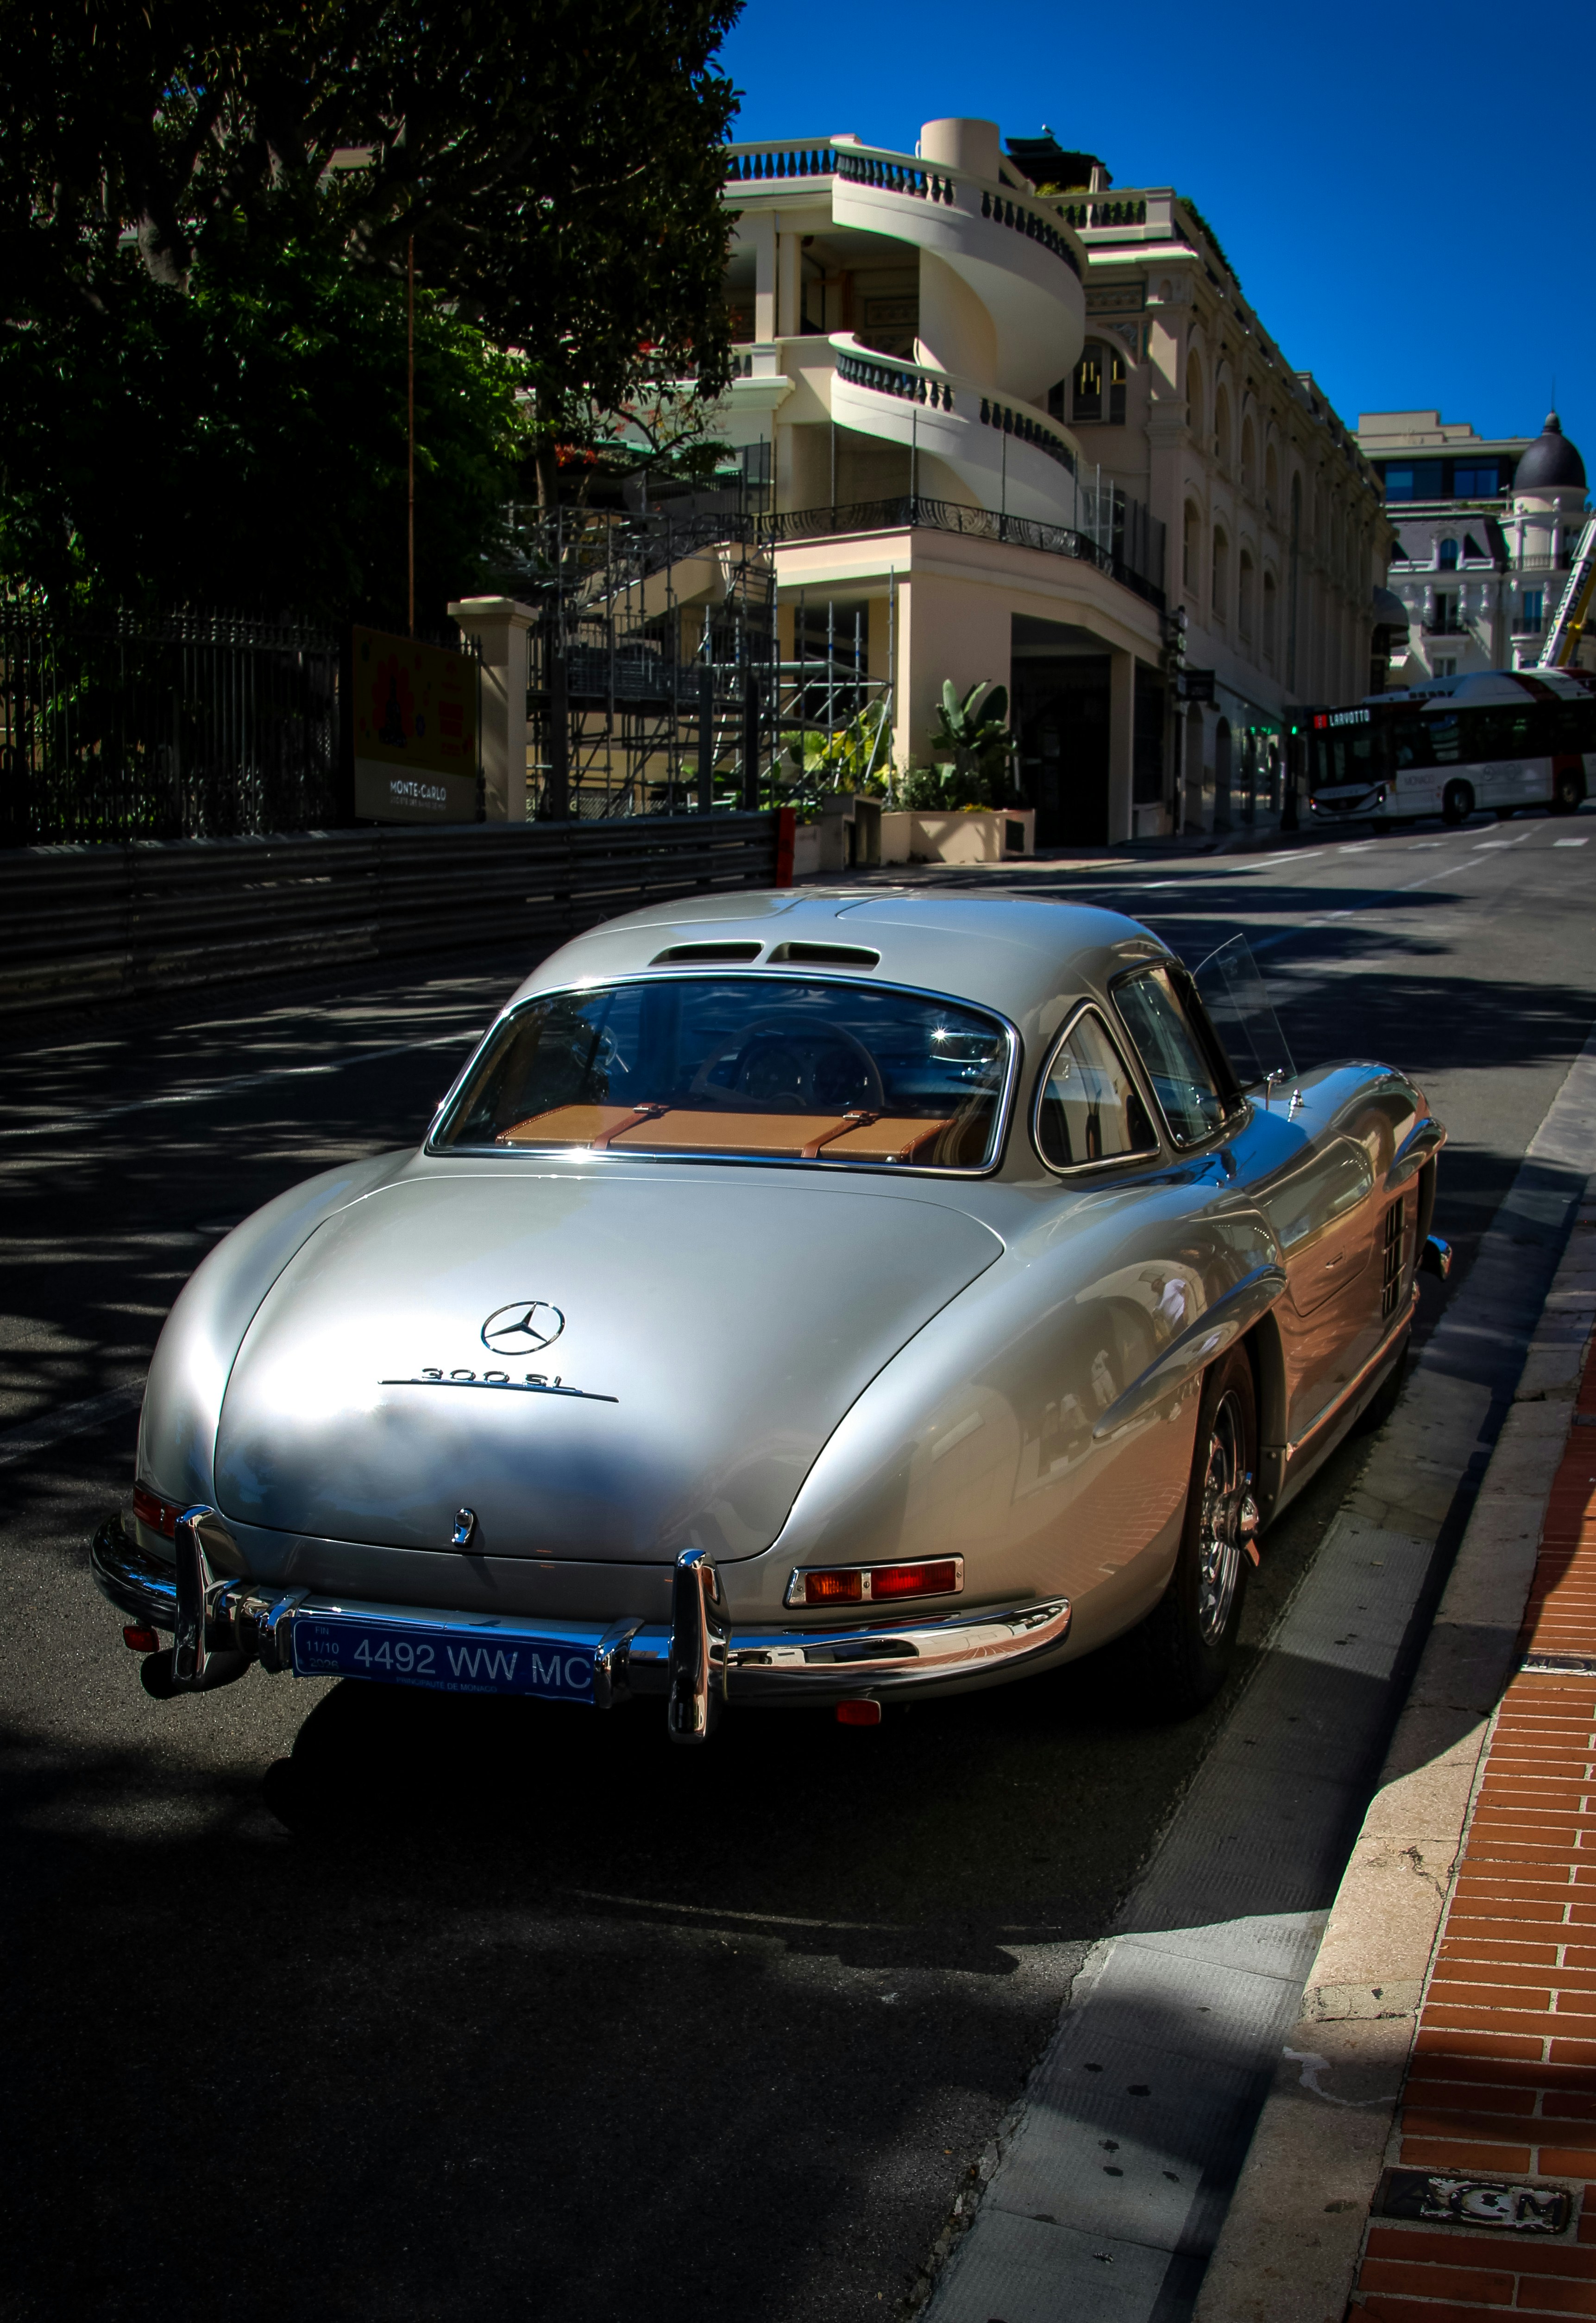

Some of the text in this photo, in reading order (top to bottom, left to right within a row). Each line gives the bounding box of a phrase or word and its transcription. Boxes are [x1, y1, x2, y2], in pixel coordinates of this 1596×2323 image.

[1329, 709, 1370, 727] LARVOTTO
[421, 1368, 577, 1391] 300 SL
[315, 1626, 329, 1635] FIN
[306, 1640, 339, 1655] 11/10
[309, 1658, 339, 1670] 2026
[353, 1639, 591, 1689] 4492 WW MC
[396, 1676, 445, 1689] PRINCIPAUTÉ
[460, 1684, 497, 1693] MONACO
[1393, 2181, 1563, 2225] ACM
